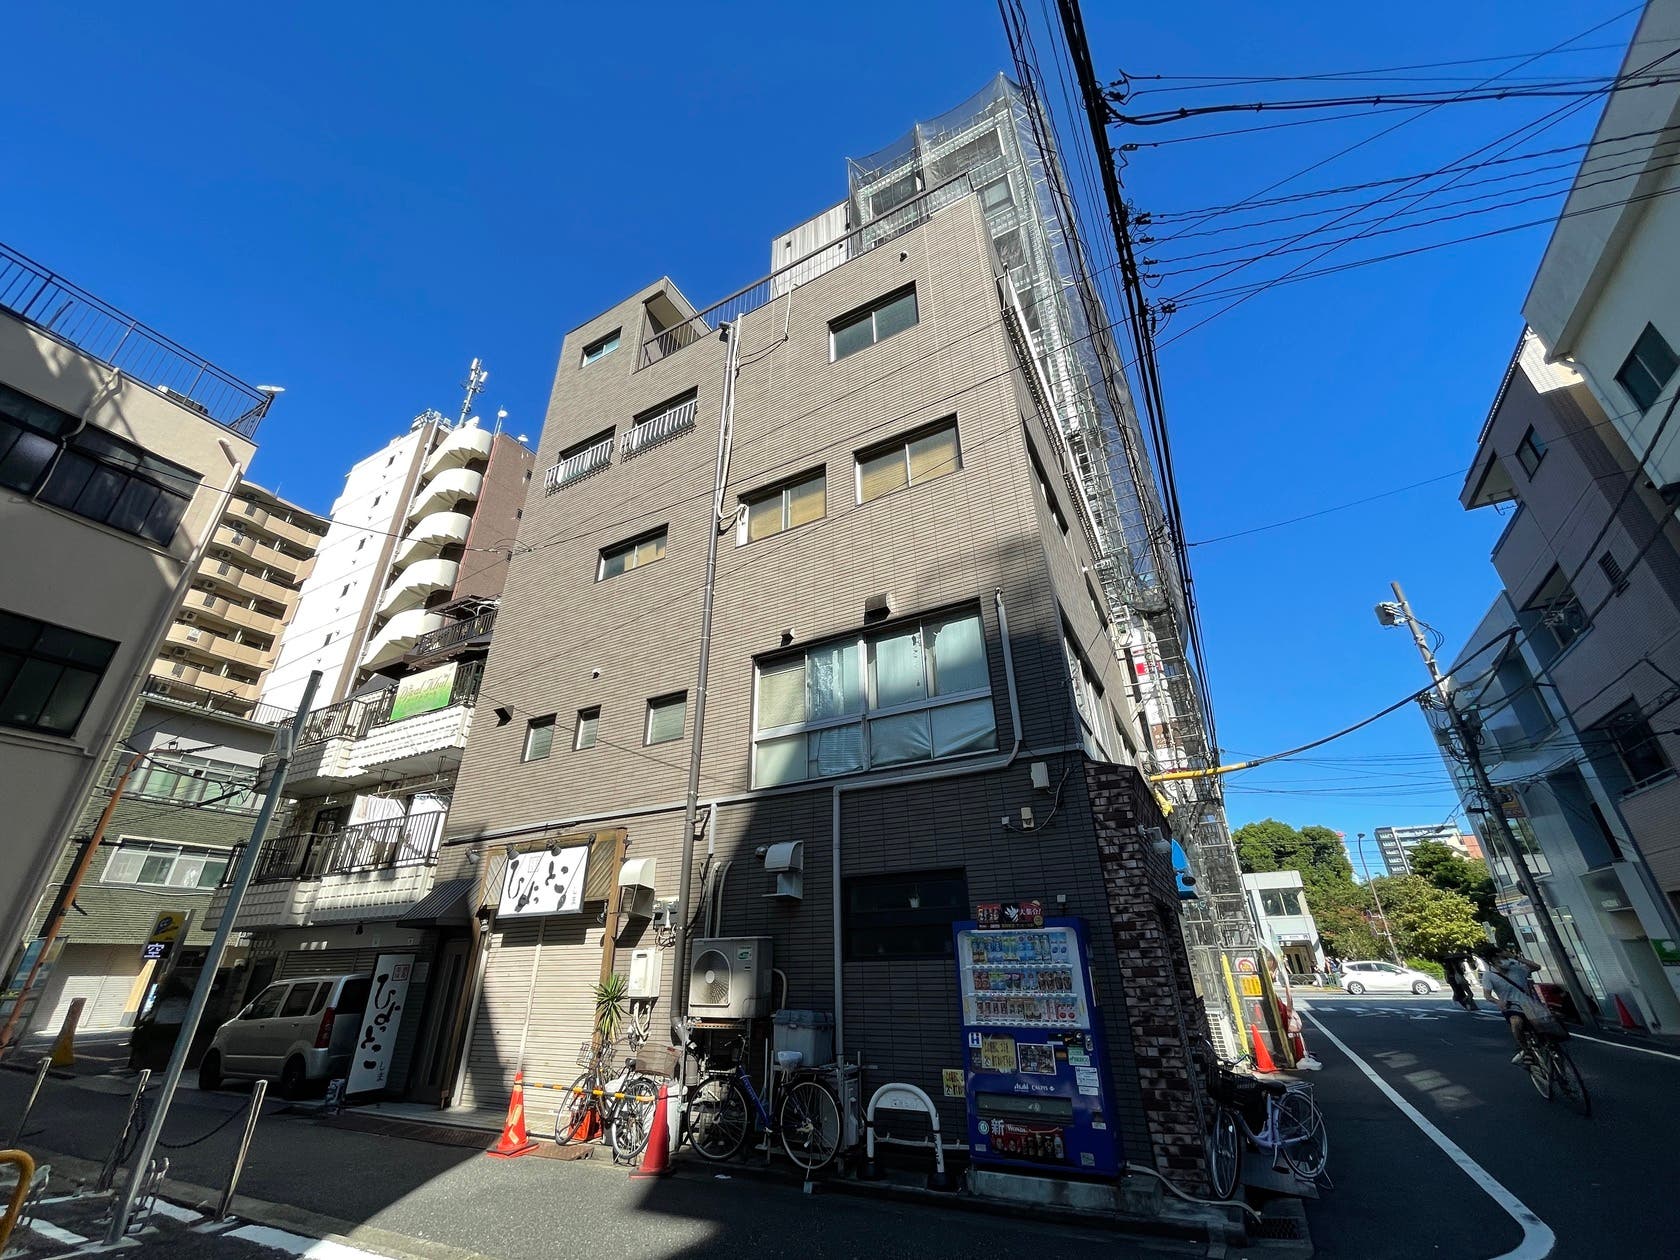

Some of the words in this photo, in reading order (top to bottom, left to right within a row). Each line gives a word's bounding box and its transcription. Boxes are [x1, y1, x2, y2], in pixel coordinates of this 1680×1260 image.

[143, 943, 165, 958] 空
[1014, 1083, 1029, 1091] Asahi
[991, 1118, 1004, 1136] 新
